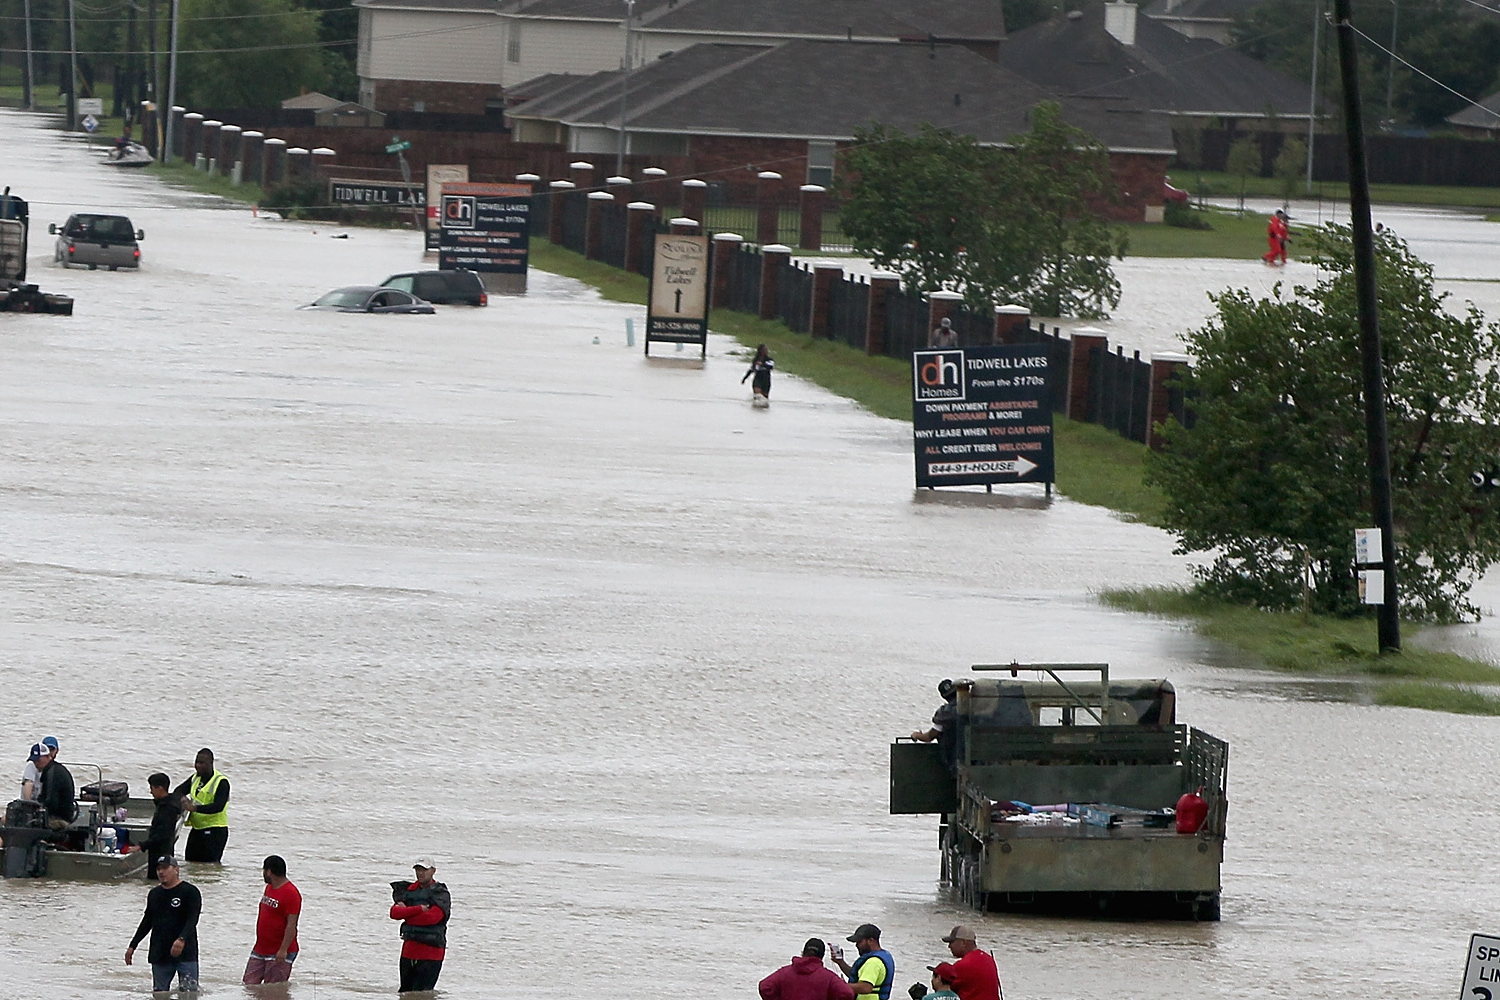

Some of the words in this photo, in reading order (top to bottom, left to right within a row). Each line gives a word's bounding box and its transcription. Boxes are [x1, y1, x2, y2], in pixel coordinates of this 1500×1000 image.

[335, 187, 389, 202] TIDWELL
[967, 358, 1012, 370] TIDWELL
[1014, 357, 1048, 368] LAKES
[921, 355, 959, 385] dh
[972, 379, 995, 387] From
[996, 378, 1011, 387] the
[921, 387, 959, 397] Homes
[925, 403, 951, 413] DOWN
[952, 402, 988, 411] PAYMENT
[915, 430, 934, 438] WHY
[935, 428, 961, 437] LEASE
[962, 427, 988, 437] WHEN
[988, 426, 1006, 435] YOU
[1007, 426, 1026, 434] CAN
[925, 446, 941, 454] ALL
[942, 444, 972, 454] CREDIT
[973, 443, 997, 453] TIERS
[931, 462, 1015, 474] 844-91-HOUSE
[1476, 946, 1500, 963] SP
